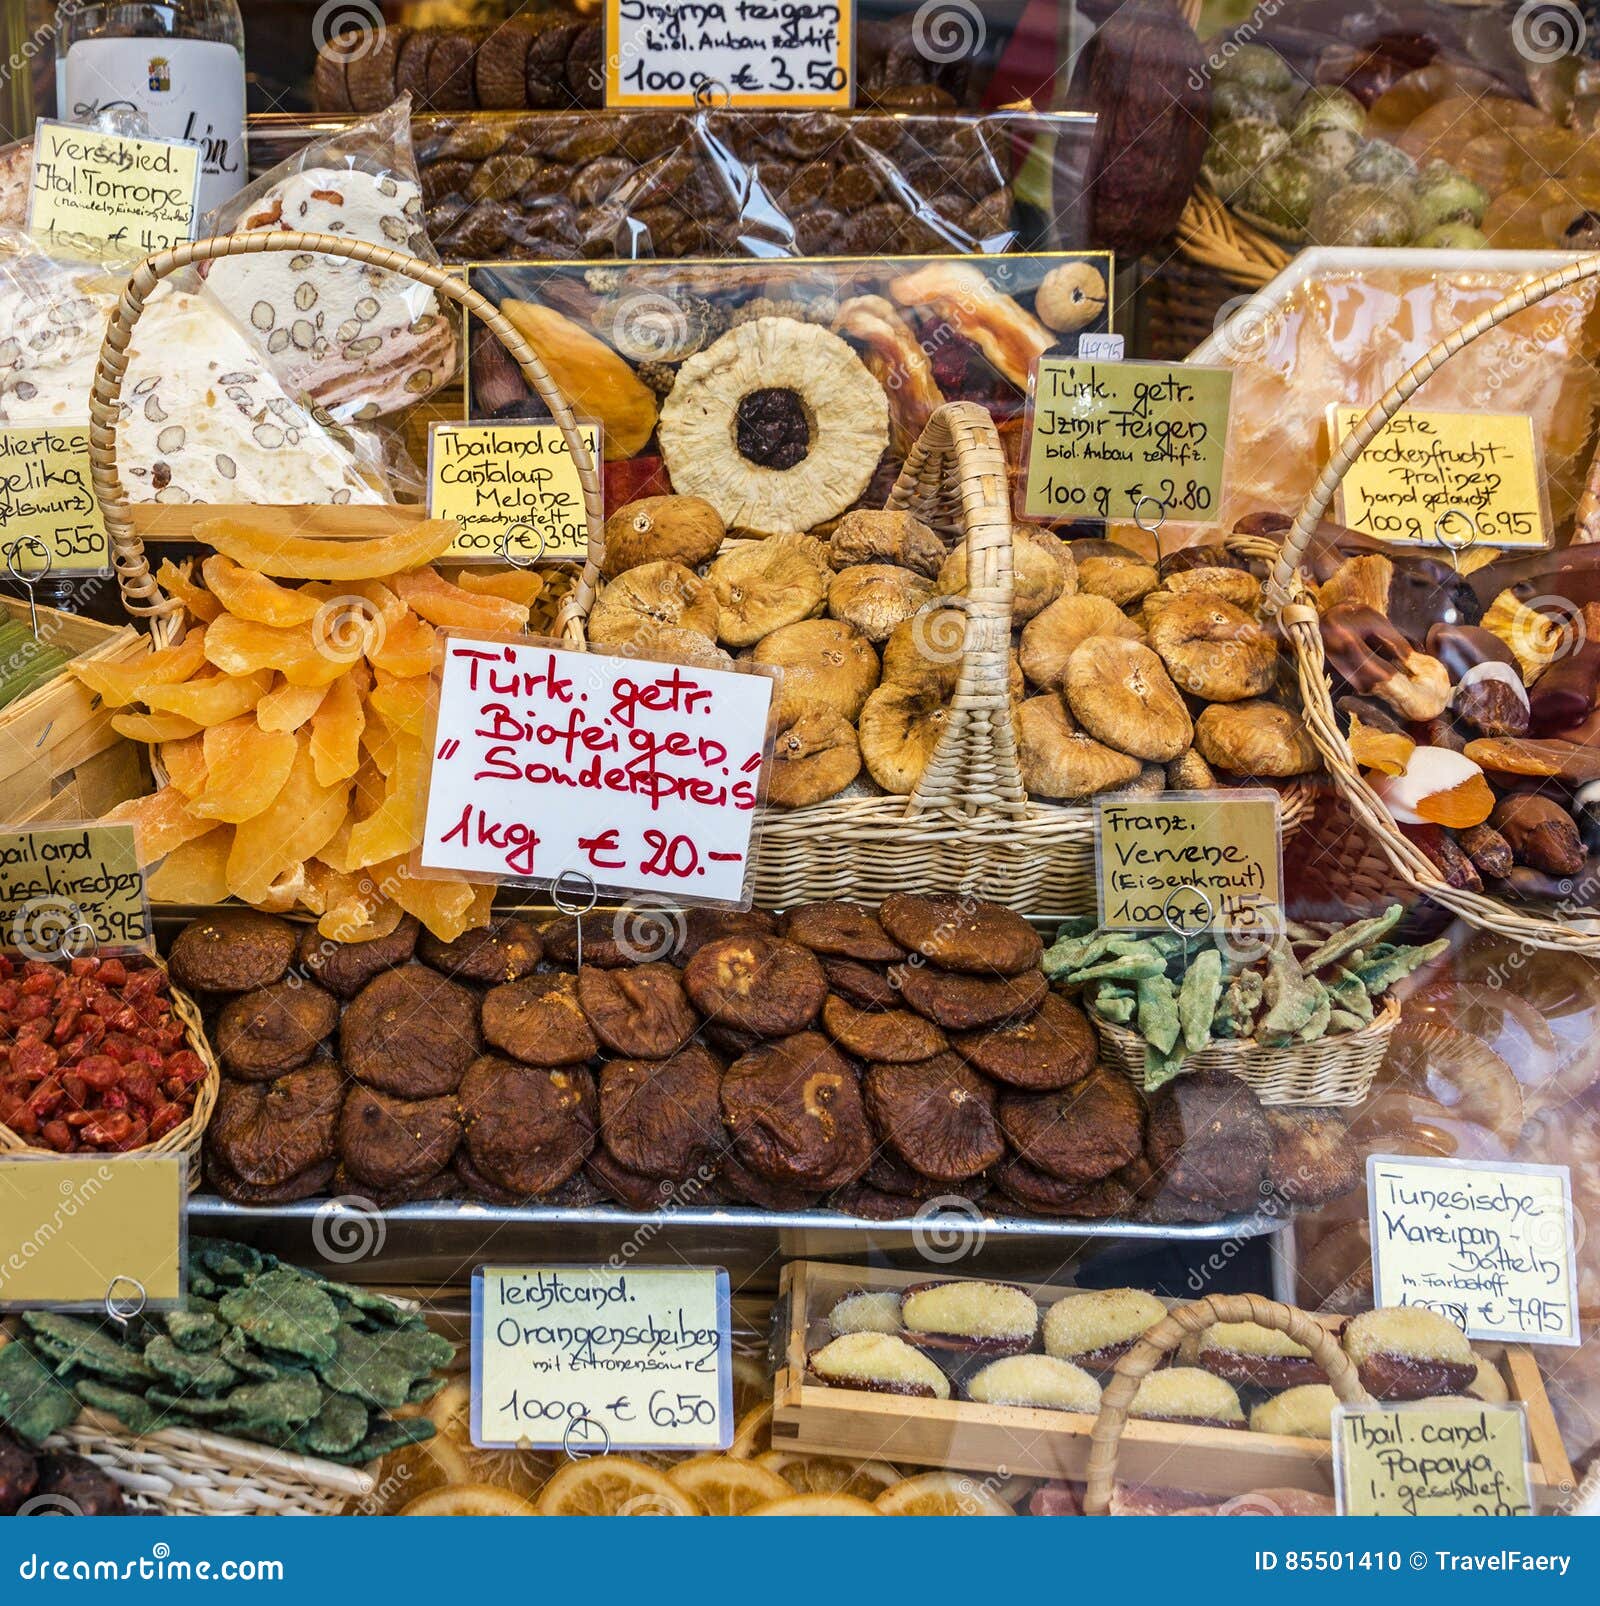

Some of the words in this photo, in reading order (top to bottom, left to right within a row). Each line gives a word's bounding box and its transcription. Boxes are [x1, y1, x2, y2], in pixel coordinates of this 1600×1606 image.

[731, 64, 764, 90] €
[769, 56, 847, 91] 3.50
[1044, 366, 1117, 398] Türk.
[1132, 374, 1195, 419] getr.
[437, 431, 544, 463] Thailand
[548, 431, 600, 454] cad.
[440, 460, 553, 491] Cantaloup
[1388, 467, 1501, 491] Pralinen
[476, 488, 580, 511] Melone
[1124, 484, 1147, 506] €
[1160, 479, 1211, 509] 2.80
[54, 525, 105, 557] 5.50
[1474, 511, 1537, 536] 6.95
[452, 646, 588, 703] Türk.
[609, 667, 713, 728] getr.
[441, 803, 541, 875] 1kg
[577, 829, 626, 869] €
[1104, 808, 1196, 835] Franz.
[93, 911, 147, 942] 3.95
[1380, 1173, 1544, 1222] Tunesische
[1448, 1246, 1560, 1285] Datteln
[1508, 1296, 1567, 1332] 7.95
[497, 1308, 721, 1362] Orangenscheiben
[532, 1355, 560, 1373] mit
[605, 1396, 637, 1422] €
[649, 1390, 716, 1428] 6.50
[1421, 1412, 1496, 1449] cand.
[1376, 1449, 1493, 1491] Papaya
